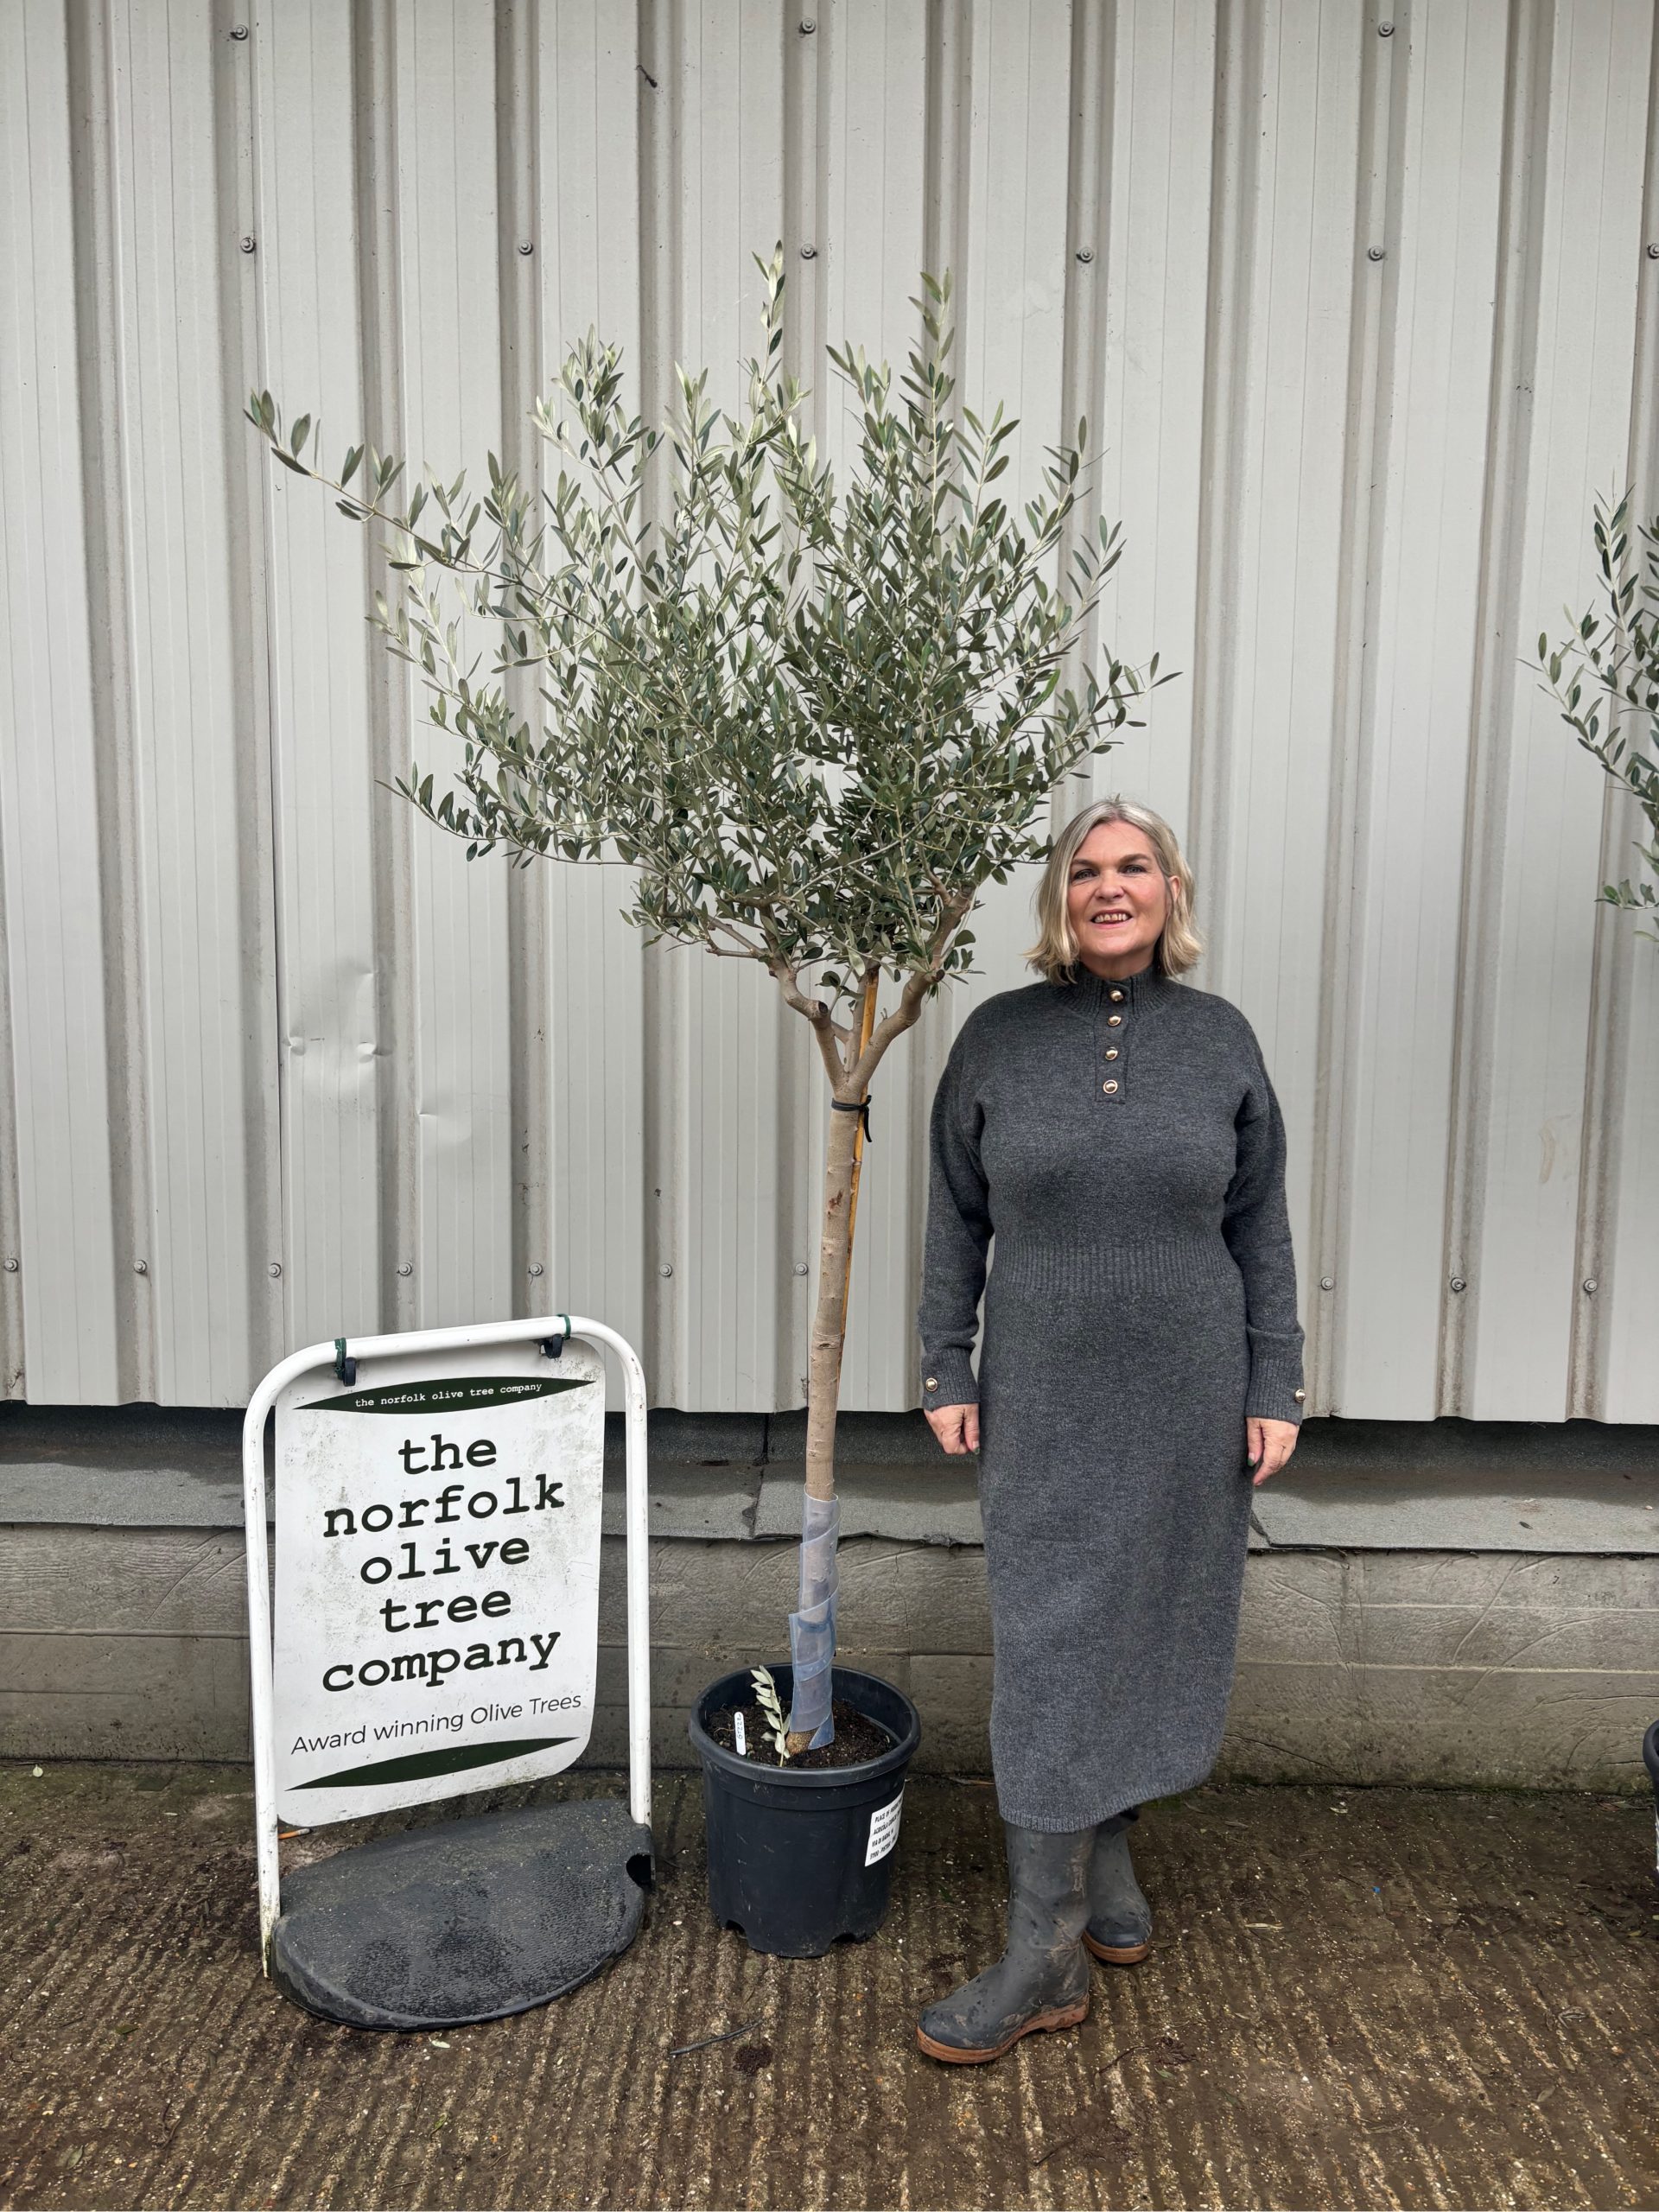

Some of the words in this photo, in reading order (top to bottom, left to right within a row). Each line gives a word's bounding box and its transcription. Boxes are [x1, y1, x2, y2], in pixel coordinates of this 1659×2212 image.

[355, 1398, 375, 1408] the
[380, 1393, 426, 1406] norfolk
[431, 1390, 464, 1401] olive
[469, 1387, 494, 1397] tree
[499, 1382, 543, 1394] company
[397, 1433, 497, 1475] the
[323, 1473, 565, 1538] norfolk
[360, 1536, 530, 1585] olive
[379, 1590, 512, 1633] tree
[322, 1631, 561, 1692] company
[290, 1725, 366, 1756] Award
[373, 1713, 464, 1741] winning
[470, 1703, 523, 1725] Olive
[529, 1694, 582, 1715] Trees
